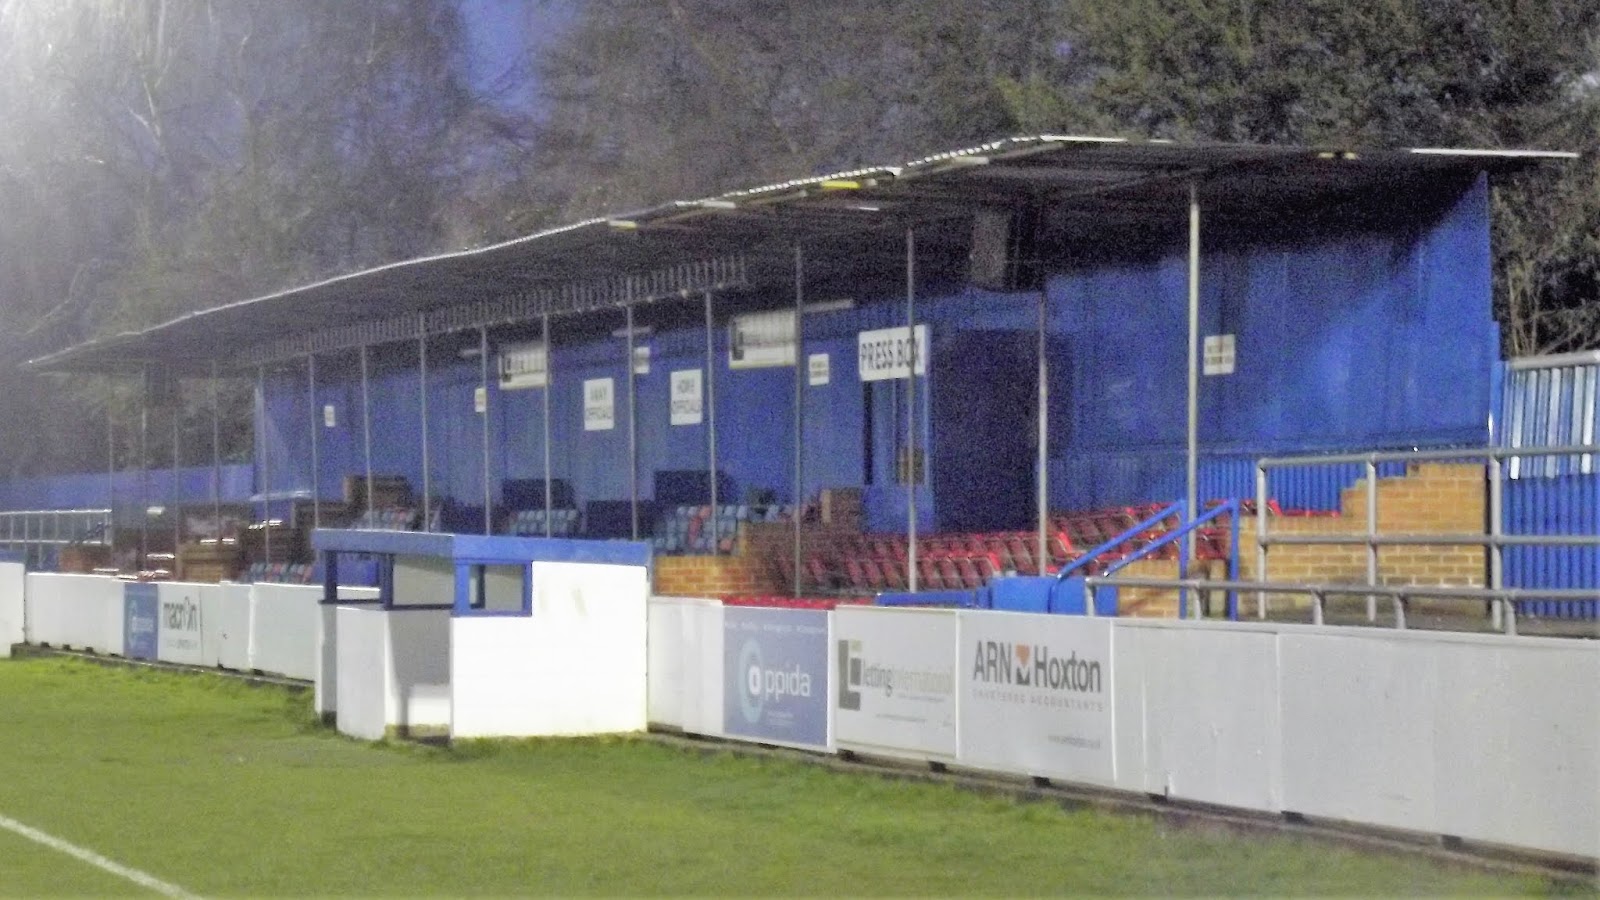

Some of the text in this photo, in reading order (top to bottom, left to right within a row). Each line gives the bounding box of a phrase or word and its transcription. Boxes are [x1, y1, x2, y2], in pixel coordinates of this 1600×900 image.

[861, 339, 894, 371] PRESS
[973, 640, 1102, 694] ARN Hoxton
